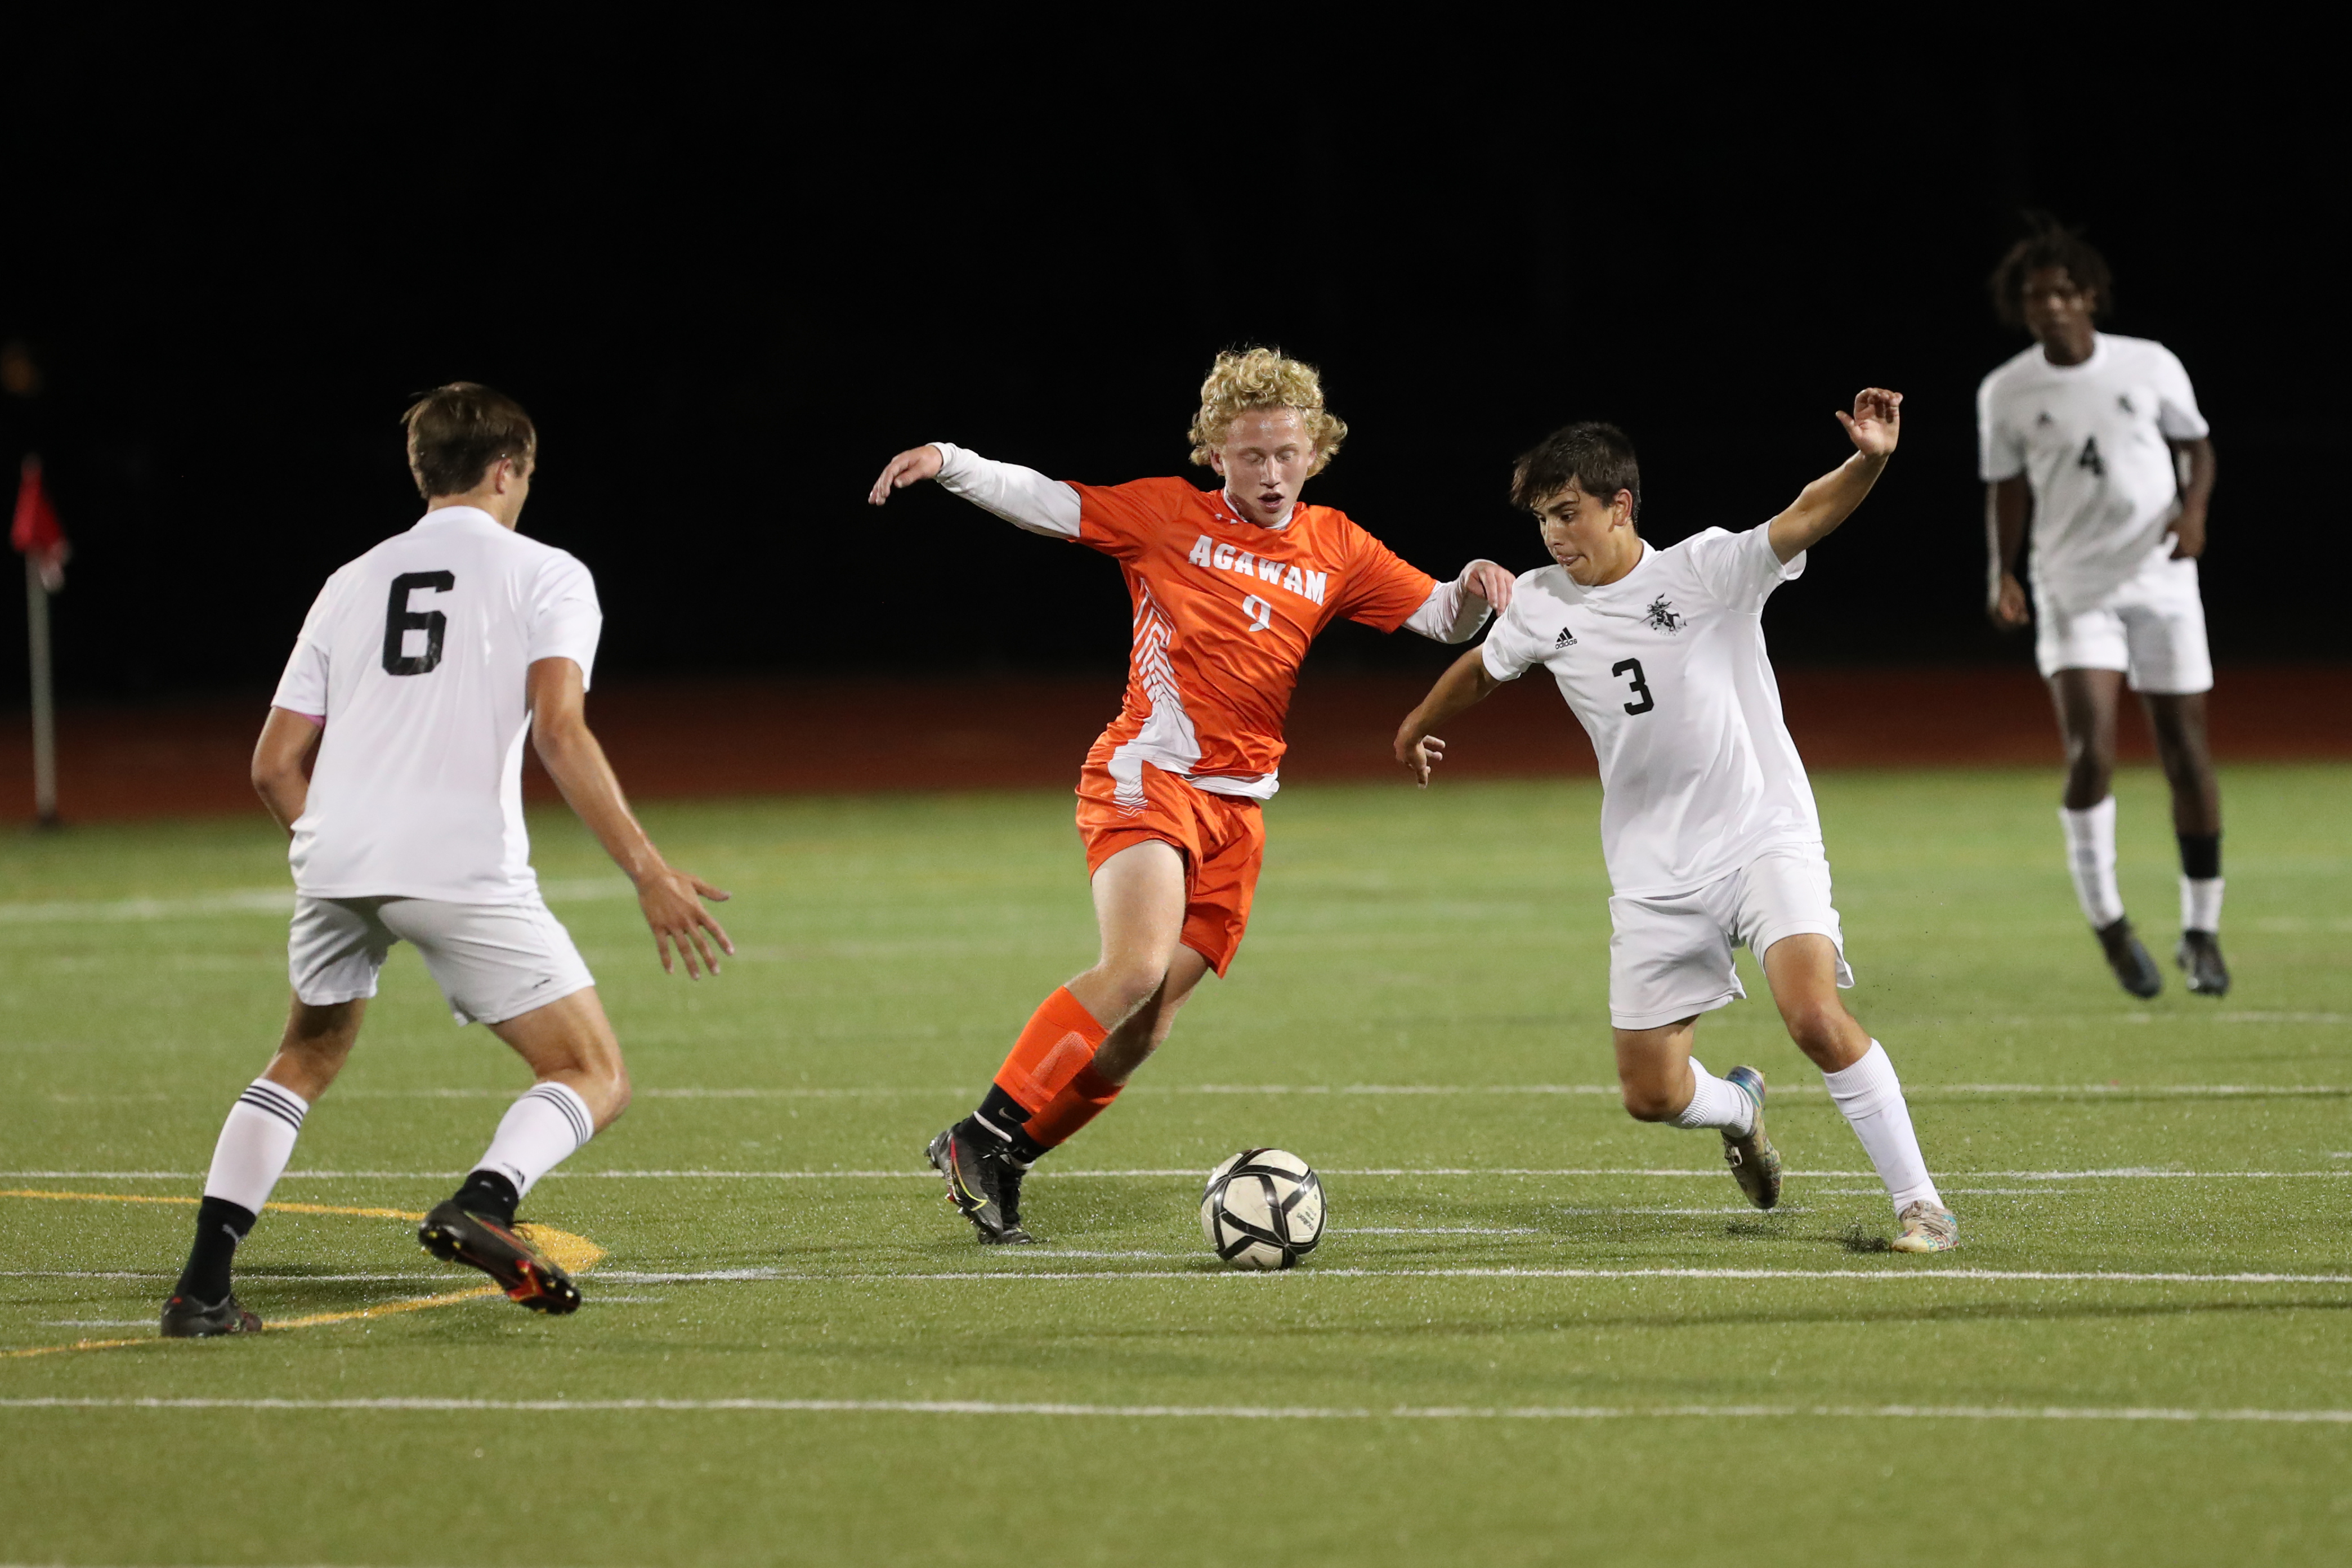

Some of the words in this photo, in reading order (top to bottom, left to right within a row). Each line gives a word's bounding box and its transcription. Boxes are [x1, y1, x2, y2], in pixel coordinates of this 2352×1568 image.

[2079, 435, 2105, 475] 4
[1188, 534, 1327, 606] AGAWAM
[382, 570, 455, 676] 6
[1242, 594, 1272, 632] 9
[1555, 638, 1577, 649] adidas
[1612, 657, 1655, 716] 3
